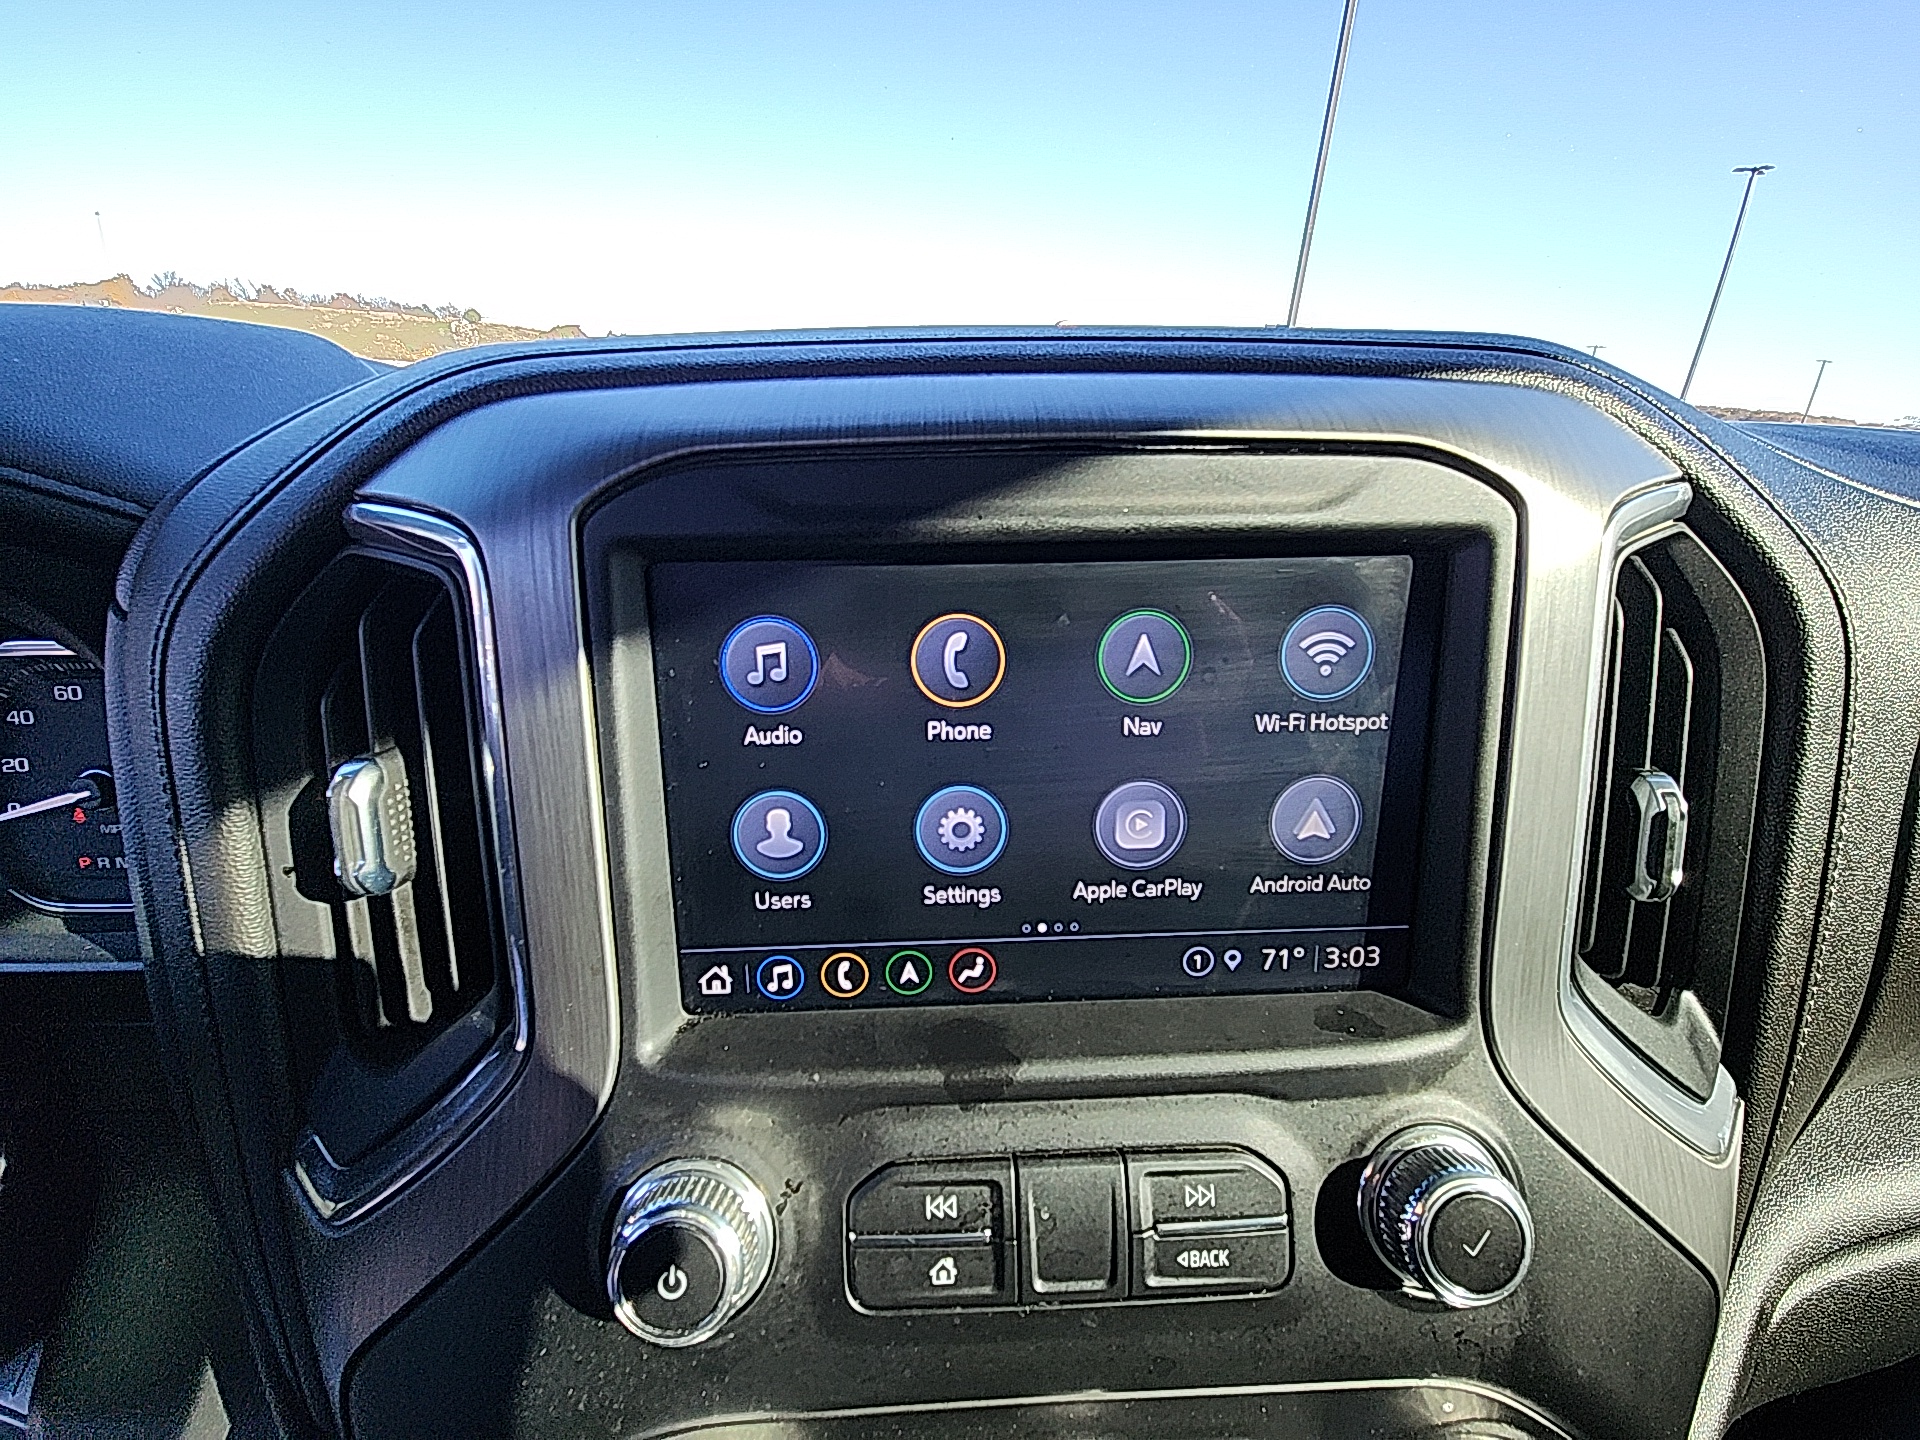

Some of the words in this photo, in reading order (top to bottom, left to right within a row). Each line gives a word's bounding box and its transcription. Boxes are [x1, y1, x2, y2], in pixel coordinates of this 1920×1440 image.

[53, 686, 82, 701] 60
[6, 710, 34, 725] 40
[1122, 716, 1162, 737] Nav
[1254, 712, 1306, 732] Wi-Fi
[1309, 712, 1389, 733] Hotspot
[743, 724, 803, 746] Audio
[926, 721, 992, 741] Phone
[2, 758, 29, 772] 20
[1072, 880, 1128, 901] Apple
[1131, 878, 1203, 901] CarPlay
[1249, 873, 1324, 893] Android
[1326, 873, 1371, 892] Auto
[754, 890, 812, 911] Users
[922, 885, 1002, 907] Settings
[1260, 948, 1306, 970] 71°
[1324, 946, 1381, 968] 3:03
[1189, 1249, 1229, 1267] BACK
